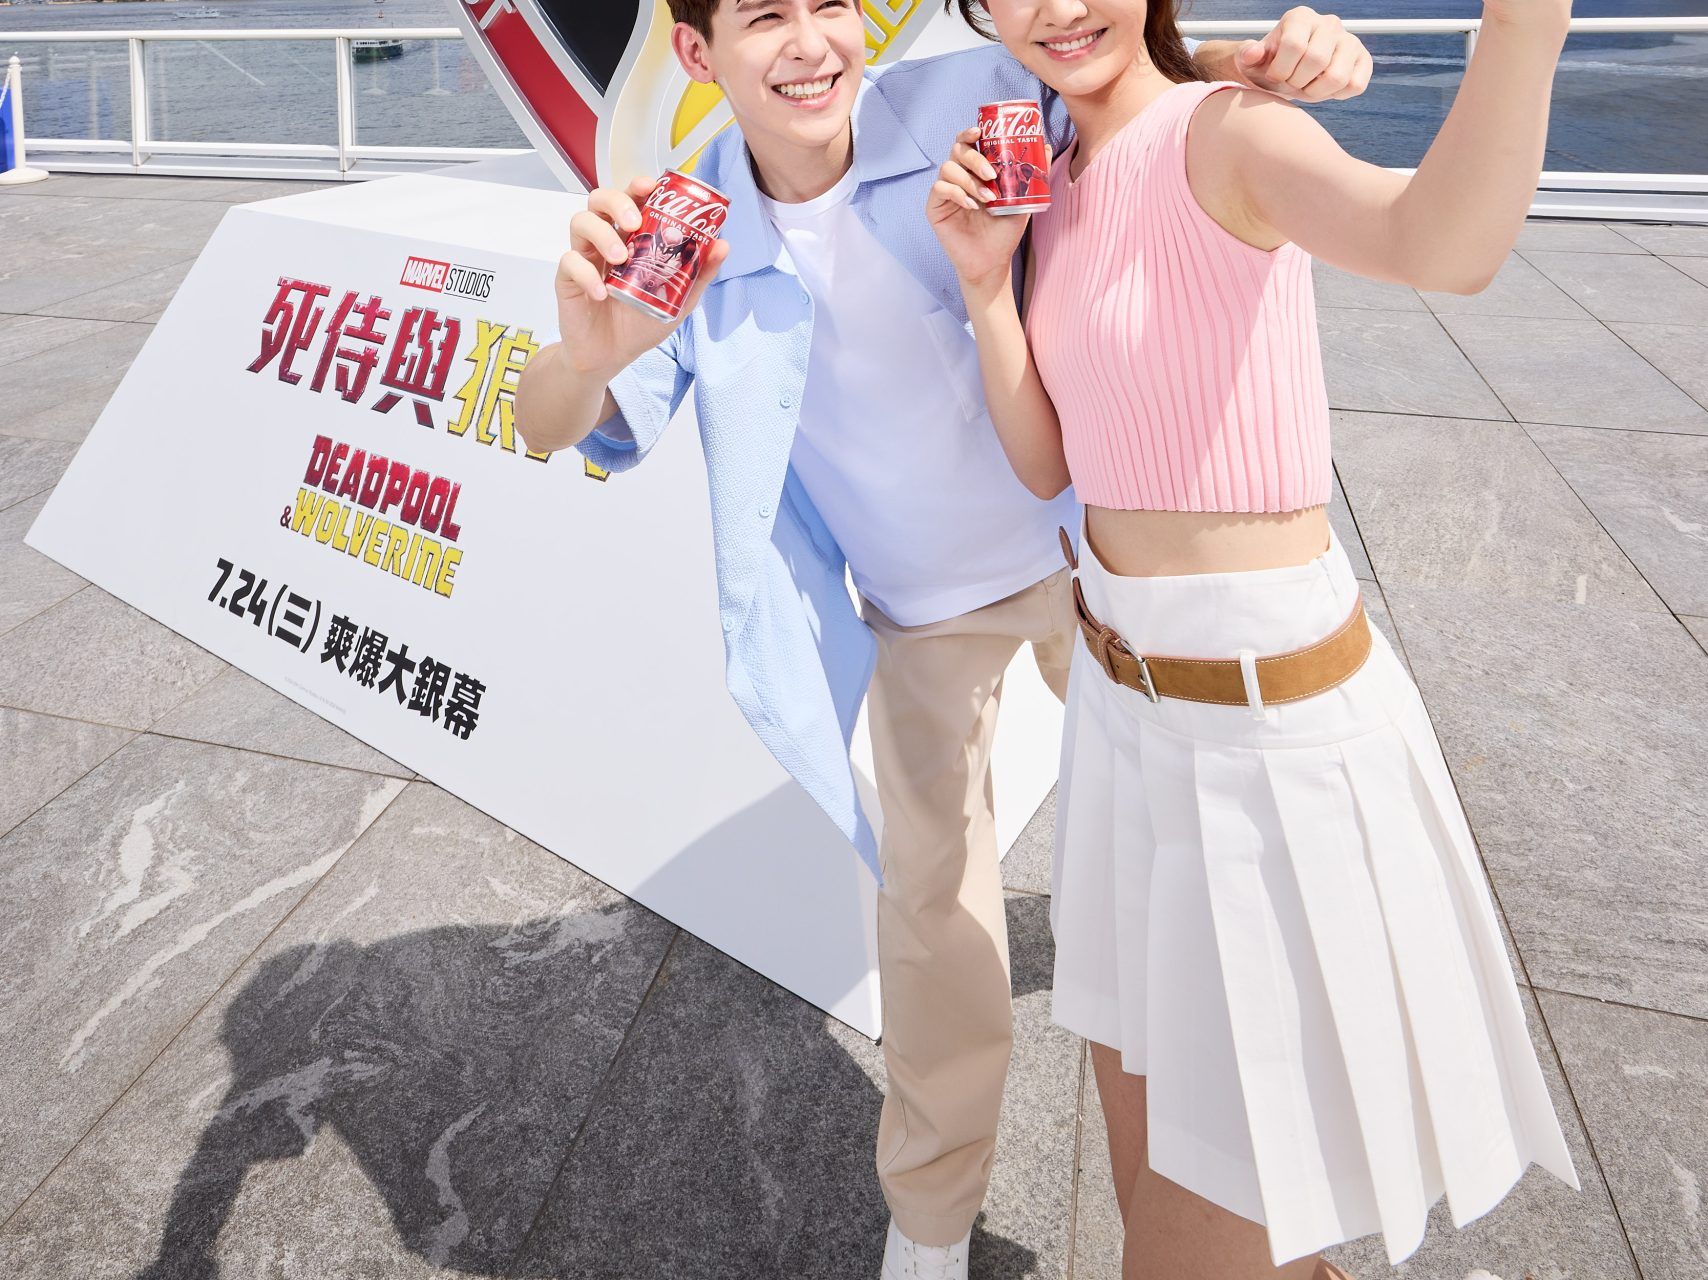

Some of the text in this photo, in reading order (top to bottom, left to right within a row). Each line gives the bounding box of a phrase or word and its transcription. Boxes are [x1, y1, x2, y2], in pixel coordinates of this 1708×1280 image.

[403, 260, 494, 298] MARVEL STUDIOS
[649, 211, 710, 245] ORIGINAL TASTE
[246, 276, 612, 482] 死侍與狼
[291, 487, 463, 599] WOLVERINE
[303, 434, 461, 542] DEADPOOL
[207, 557, 486, 741] 7.24(三) 爽爆大銀幕
